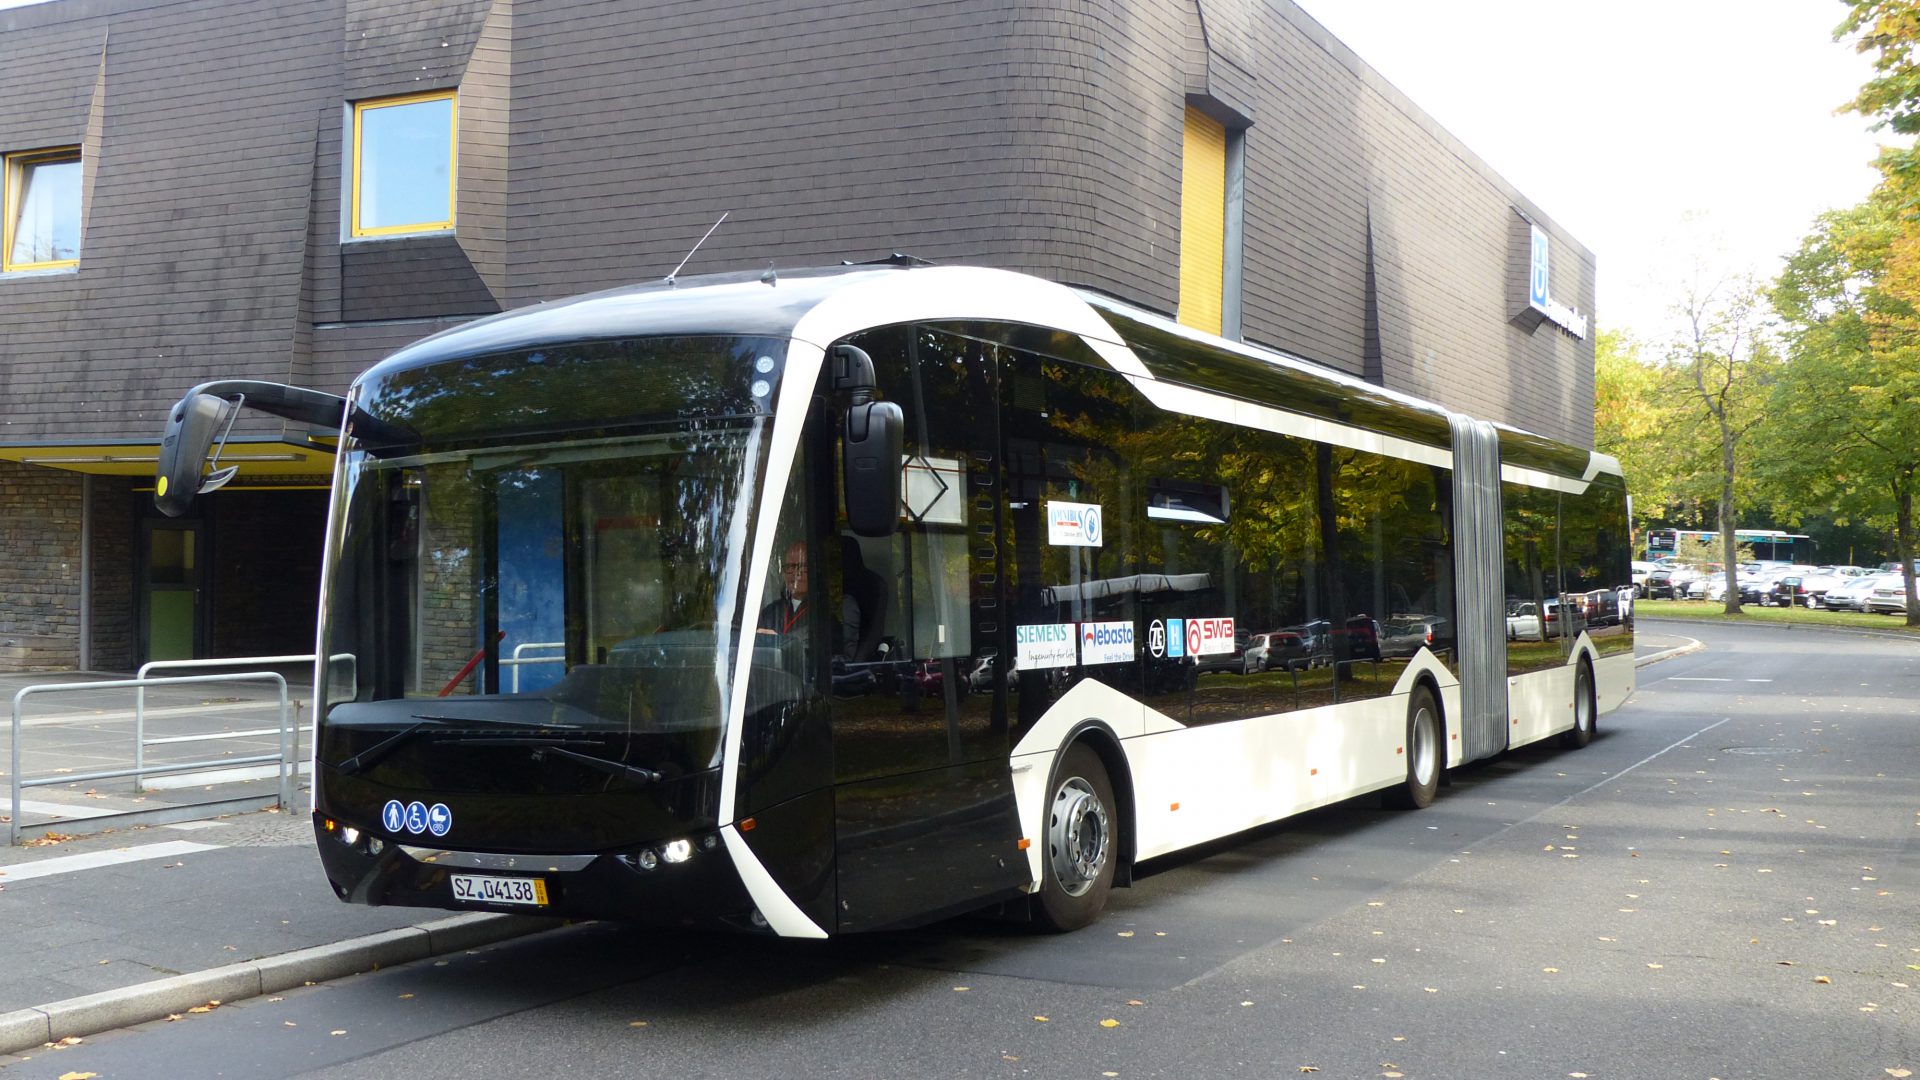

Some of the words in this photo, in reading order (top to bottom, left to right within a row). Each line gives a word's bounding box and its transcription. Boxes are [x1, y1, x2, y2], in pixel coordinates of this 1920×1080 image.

[1017, 624, 1067, 643] SIEMENS
[1082, 623, 1133, 648] Webasto
[1203, 619, 1234, 639] SWB
